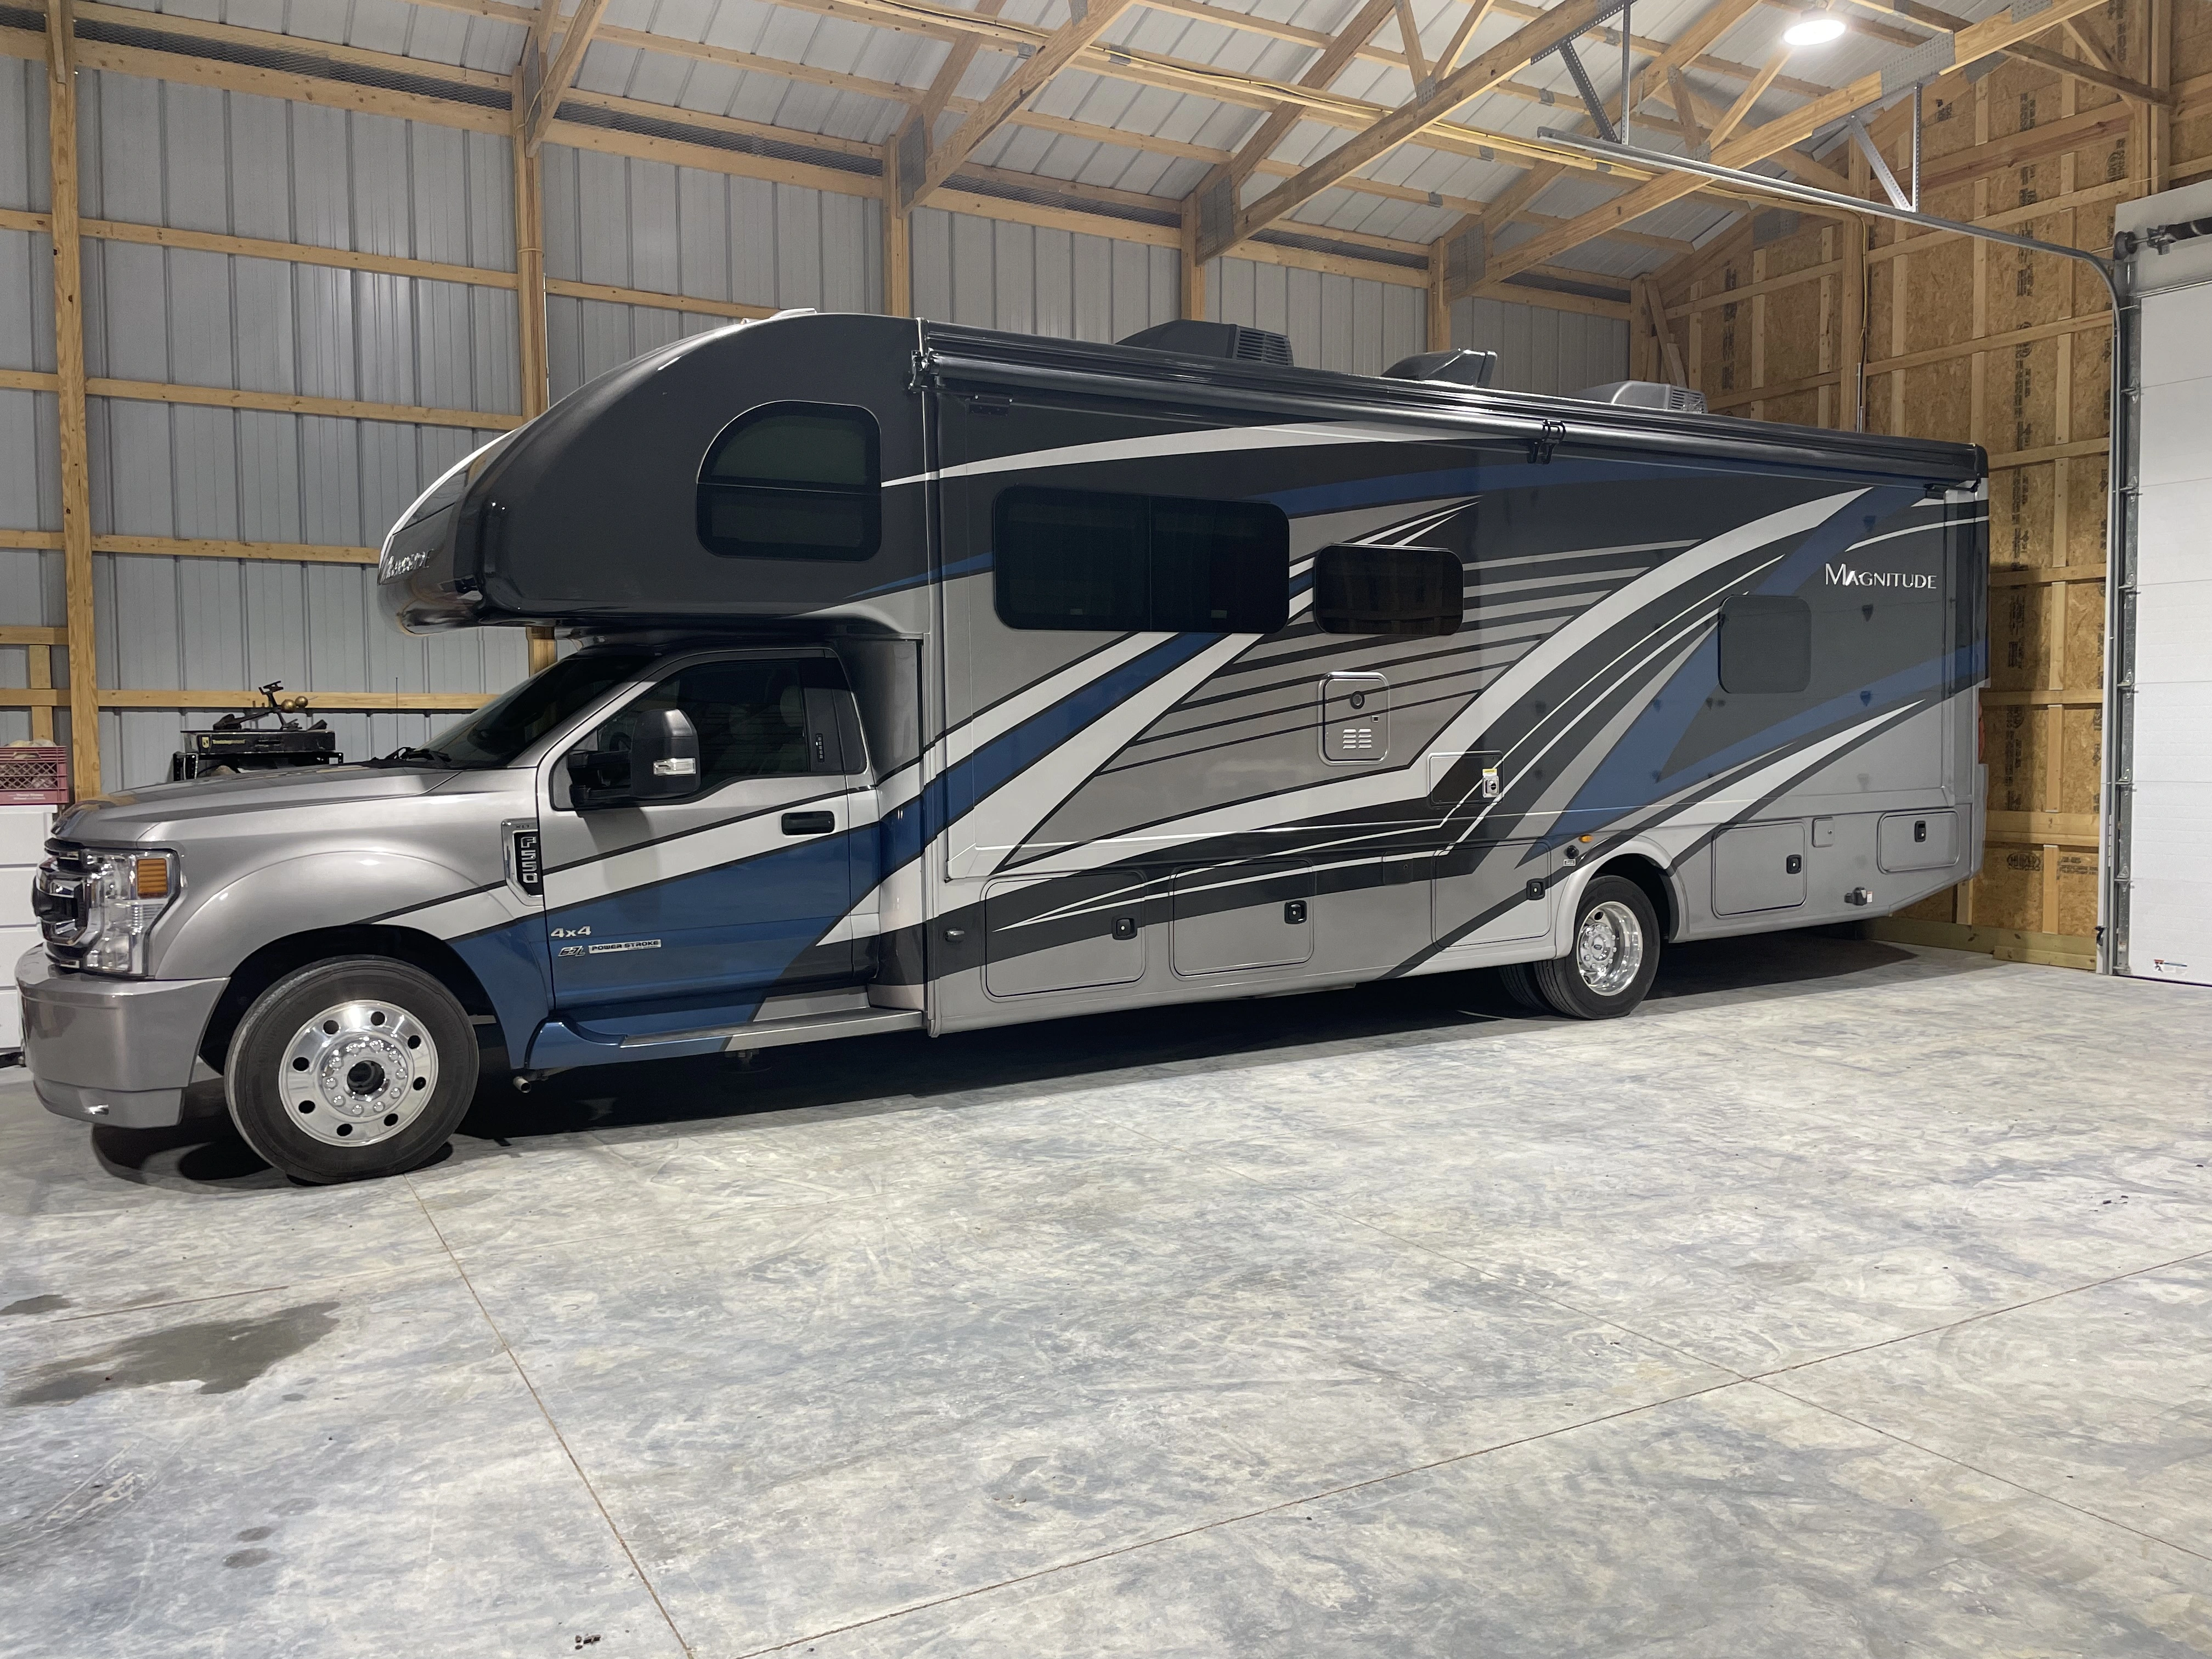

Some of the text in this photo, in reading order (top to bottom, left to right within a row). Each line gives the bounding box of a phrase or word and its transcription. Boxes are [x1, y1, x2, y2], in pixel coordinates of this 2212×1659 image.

[1825, 563, 1937, 589] MAGNITUDE
[521, 836, 538, 883] F550
[550, 926, 591, 938] 4x4
[624, 940, 659, 948] STROKE
